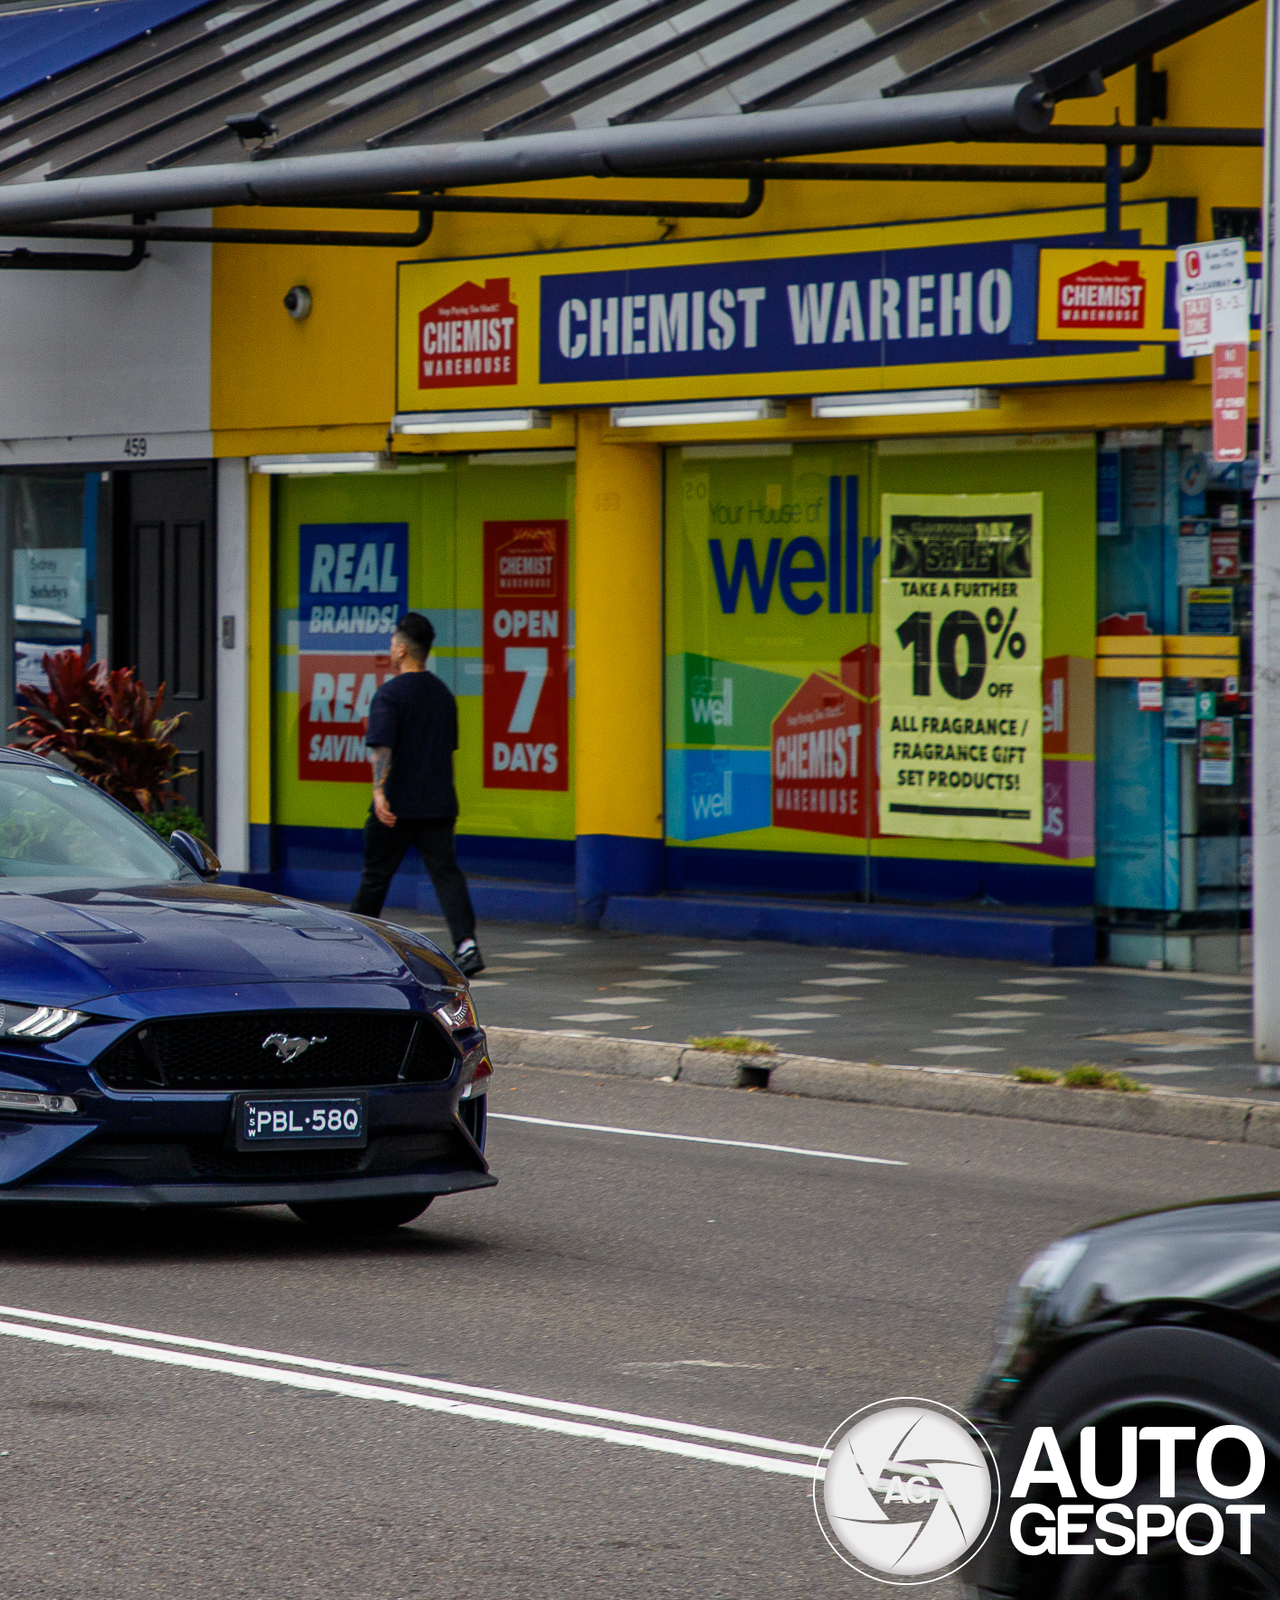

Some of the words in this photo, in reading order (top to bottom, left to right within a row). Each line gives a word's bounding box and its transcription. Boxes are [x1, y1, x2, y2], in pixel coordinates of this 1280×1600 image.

[1061, 284, 1143, 308] CHEMIST
[558, 286, 767, 360] CHEMIST
[1061, 309, 1139, 322] WAREHOUSE
[423, 317, 515, 355] CHEMIST
[423, 355, 511, 377] WAREHOUSE
[123, 437, 147, 457] 459
[709, 503, 744, 525] Your
[749, 500, 801, 525] House
[806, 497, 823, 523] of
[309, 543, 399, 593] REAL
[499, 555, 553, 576] CHEMIST
[925, 541, 991, 572] SALE
[901, 582, 937, 597] TAKE
[939, 582, 951, 597] A
[954, 582, 1018, 597] FURTHER
[308, 604, 399, 634] BRANDS!
[493, 609, 559, 638] OPEN
[895, 606, 1026, 700] 10%
[309, 672, 394, 723] REA
[504, 647, 549, 733] 7
[691, 677, 733, 727] well
[987, 682, 1013, 698] OFF
[890, 715, 919, 732] ALL
[922, 716, 1017, 736] FRAGRANCE
[308, 734, 374, 763] SAVIN
[492, 742, 559, 774] DAYS
[775, 723, 862, 780] CHEMIST
[892, 742, 988, 763] FRAGRANCE
[992, 745, 1027, 764] GIFT
[897, 769, 924, 786] SET
[927, 769, 1021, 791] PRODUCTS!
[691, 770, 733, 820] well
[776, 788, 859, 815] WAREHOUSE
